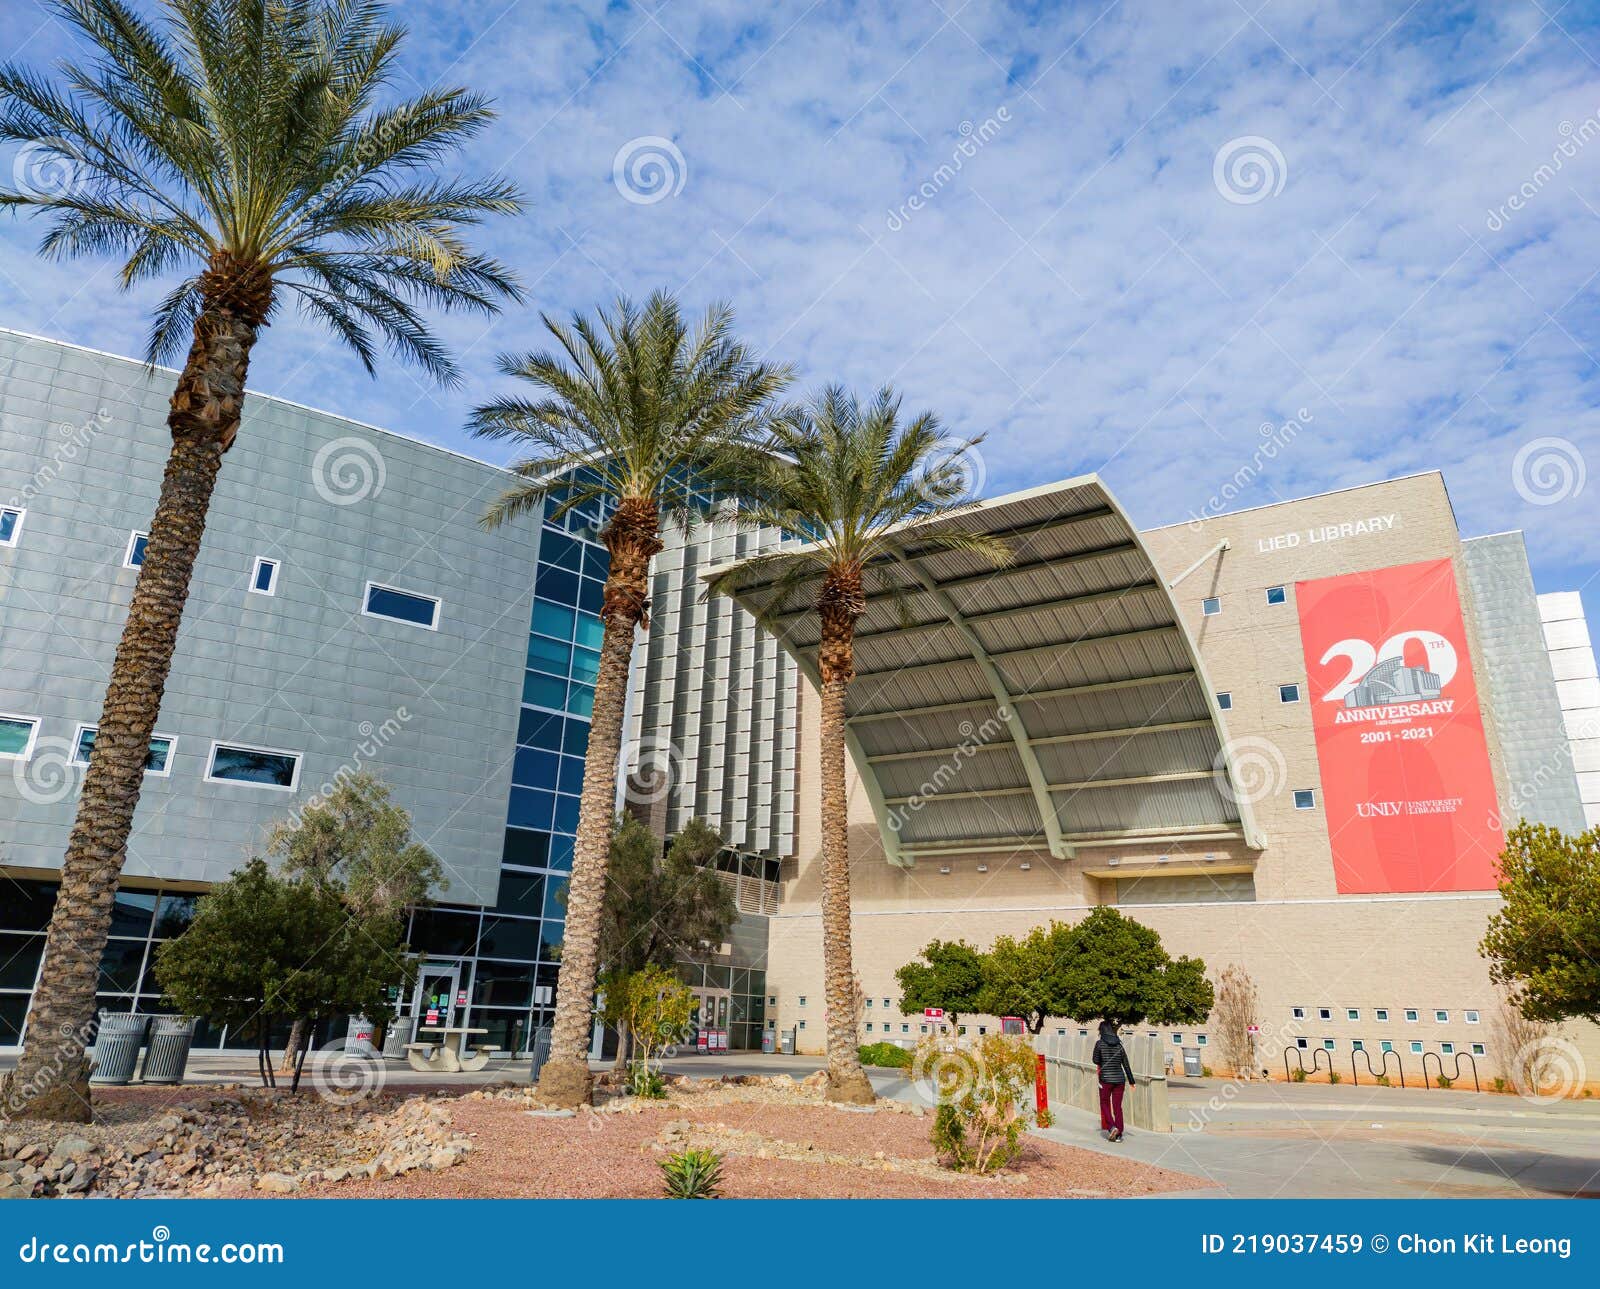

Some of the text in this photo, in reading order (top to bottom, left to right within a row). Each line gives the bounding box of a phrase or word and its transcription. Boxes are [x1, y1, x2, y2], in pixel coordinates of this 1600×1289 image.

[1258, 513, 1396, 553] LIED LIBRARY
[1335, 700, 1455, 724] ANNIVERSARY
[1360, 731, 1392, 744] 2001
[1401, 727, 1434, 740] 2021
[1356, 801, 1403, 817] UNLV
[1408, 798, 1463, 808] UNIVERSITY
[1409, 805, 1456, 815] LIBRARIES
